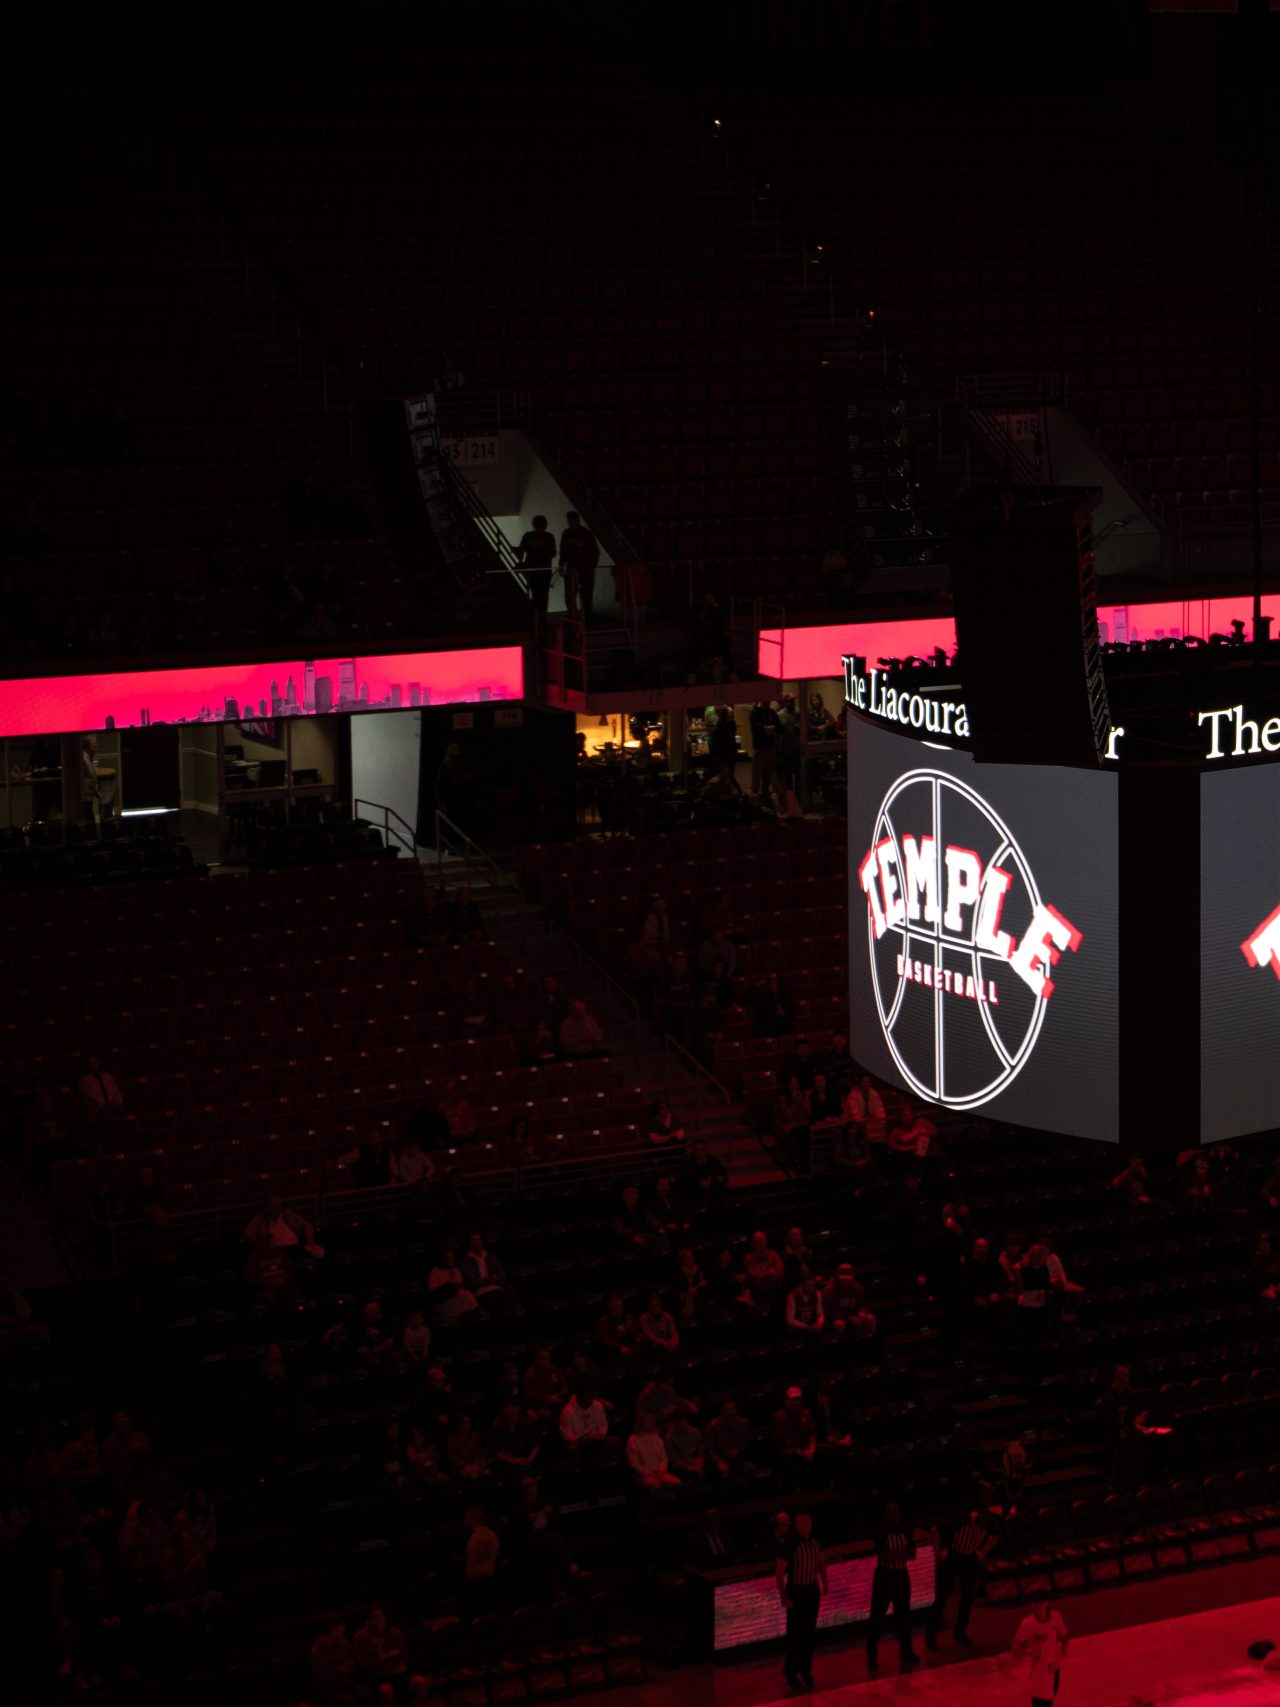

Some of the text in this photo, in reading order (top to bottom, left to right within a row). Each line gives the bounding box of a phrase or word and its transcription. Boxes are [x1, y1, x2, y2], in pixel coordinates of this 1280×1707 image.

[471, 441, 496, 459] 214
[841, 655, 971, 738] The Liacoura
[858, 834, 1084, 1000] TEMPLE
[896, 954, 999, 1004] BASKETBALL
